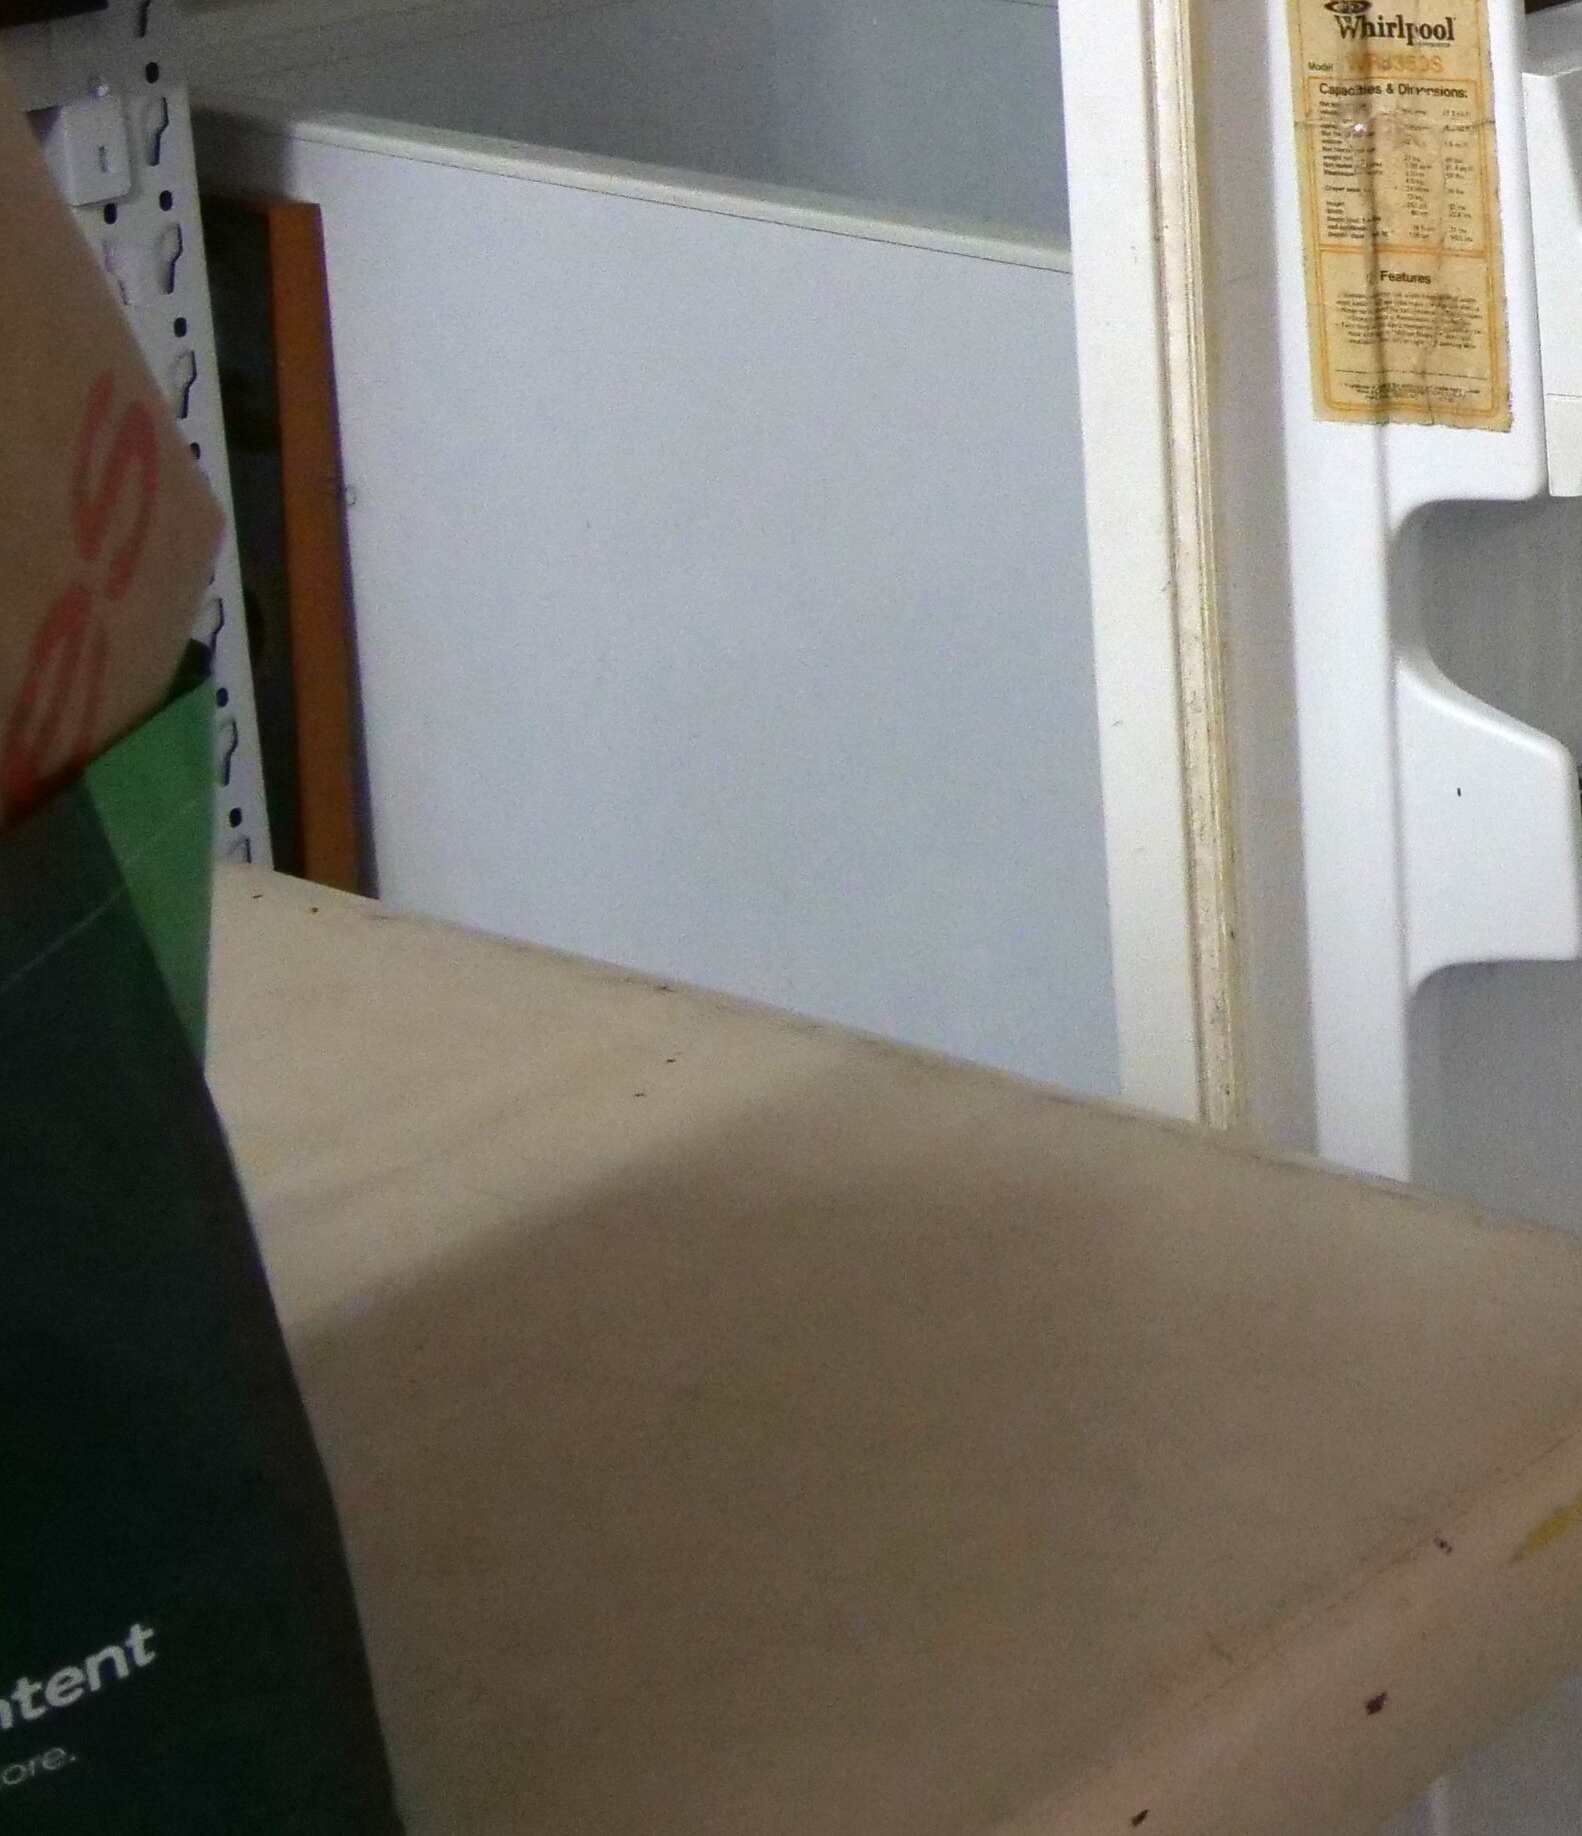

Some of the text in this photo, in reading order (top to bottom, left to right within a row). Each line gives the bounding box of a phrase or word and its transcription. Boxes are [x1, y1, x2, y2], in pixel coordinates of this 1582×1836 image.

[1333, 15, 1456, 46] Whirlpool
[1308, 62, 1333, 72] Model
[1386, 85, 1393, 94] &
[1380, 270, 1431, 284] Features
